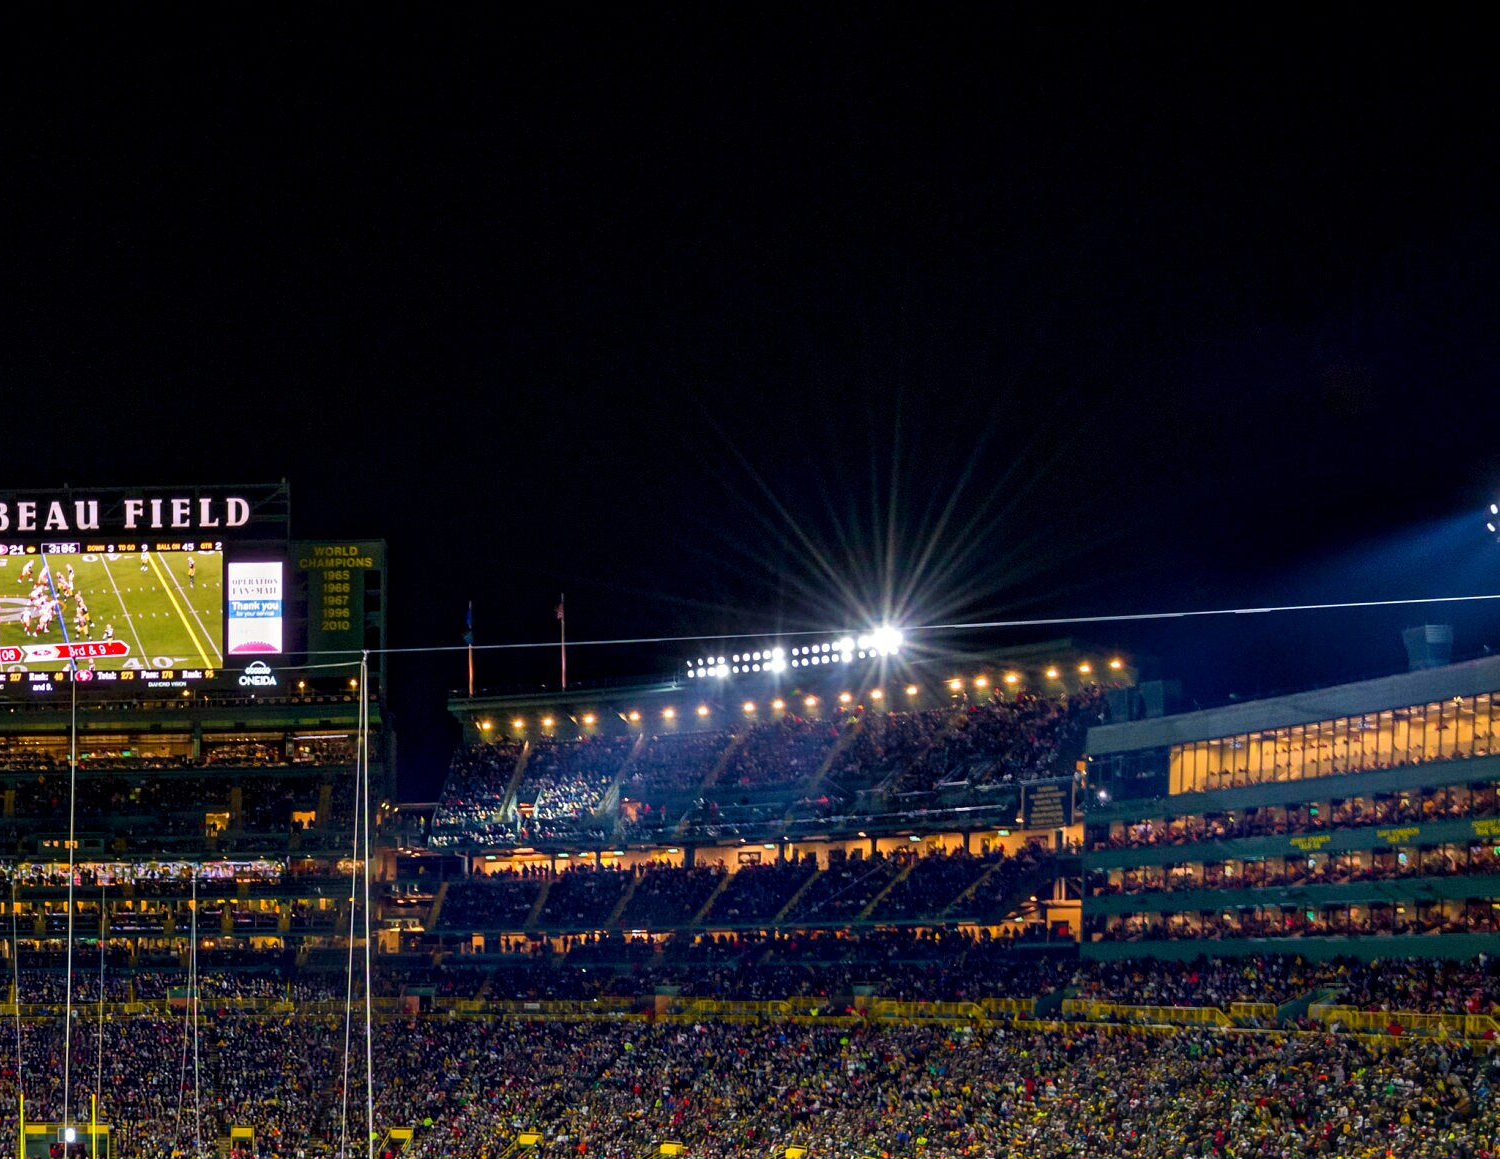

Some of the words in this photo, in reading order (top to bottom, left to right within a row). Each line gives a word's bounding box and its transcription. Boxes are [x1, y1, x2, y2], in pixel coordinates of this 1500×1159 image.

[124, 497, 250, 529] FIELD
[9, 545, 26, 556] 21
[107, 544, 115, 553] 3
[182, 542, 195, 551] 45
[215, 541, 223, 550] 2
[314, 546, 358, 557] WORLD
[300, 557, 373, 568] CHAMPIONS
[323, 570, 349, 580] 1965
[323, 595, 349, 605] 1967
[231, 601, 260, 610] Thank
[261, 602, 279, 612] you
[322, 620, 350, 631] 2010
[88, 645, 97, 655] &
[10, 672, 22, 681] 217
[29, 672, 49, 681] Rush:
[97, 671, 117, 680] Total:
[141, 671, 159, 679] Pass:
[182, 670, 202, 679] Rush:
[204, 670, 214, 678] 95
[239, 676, 277, 686] ONEIDA
[32, 683, 45, 691] and
